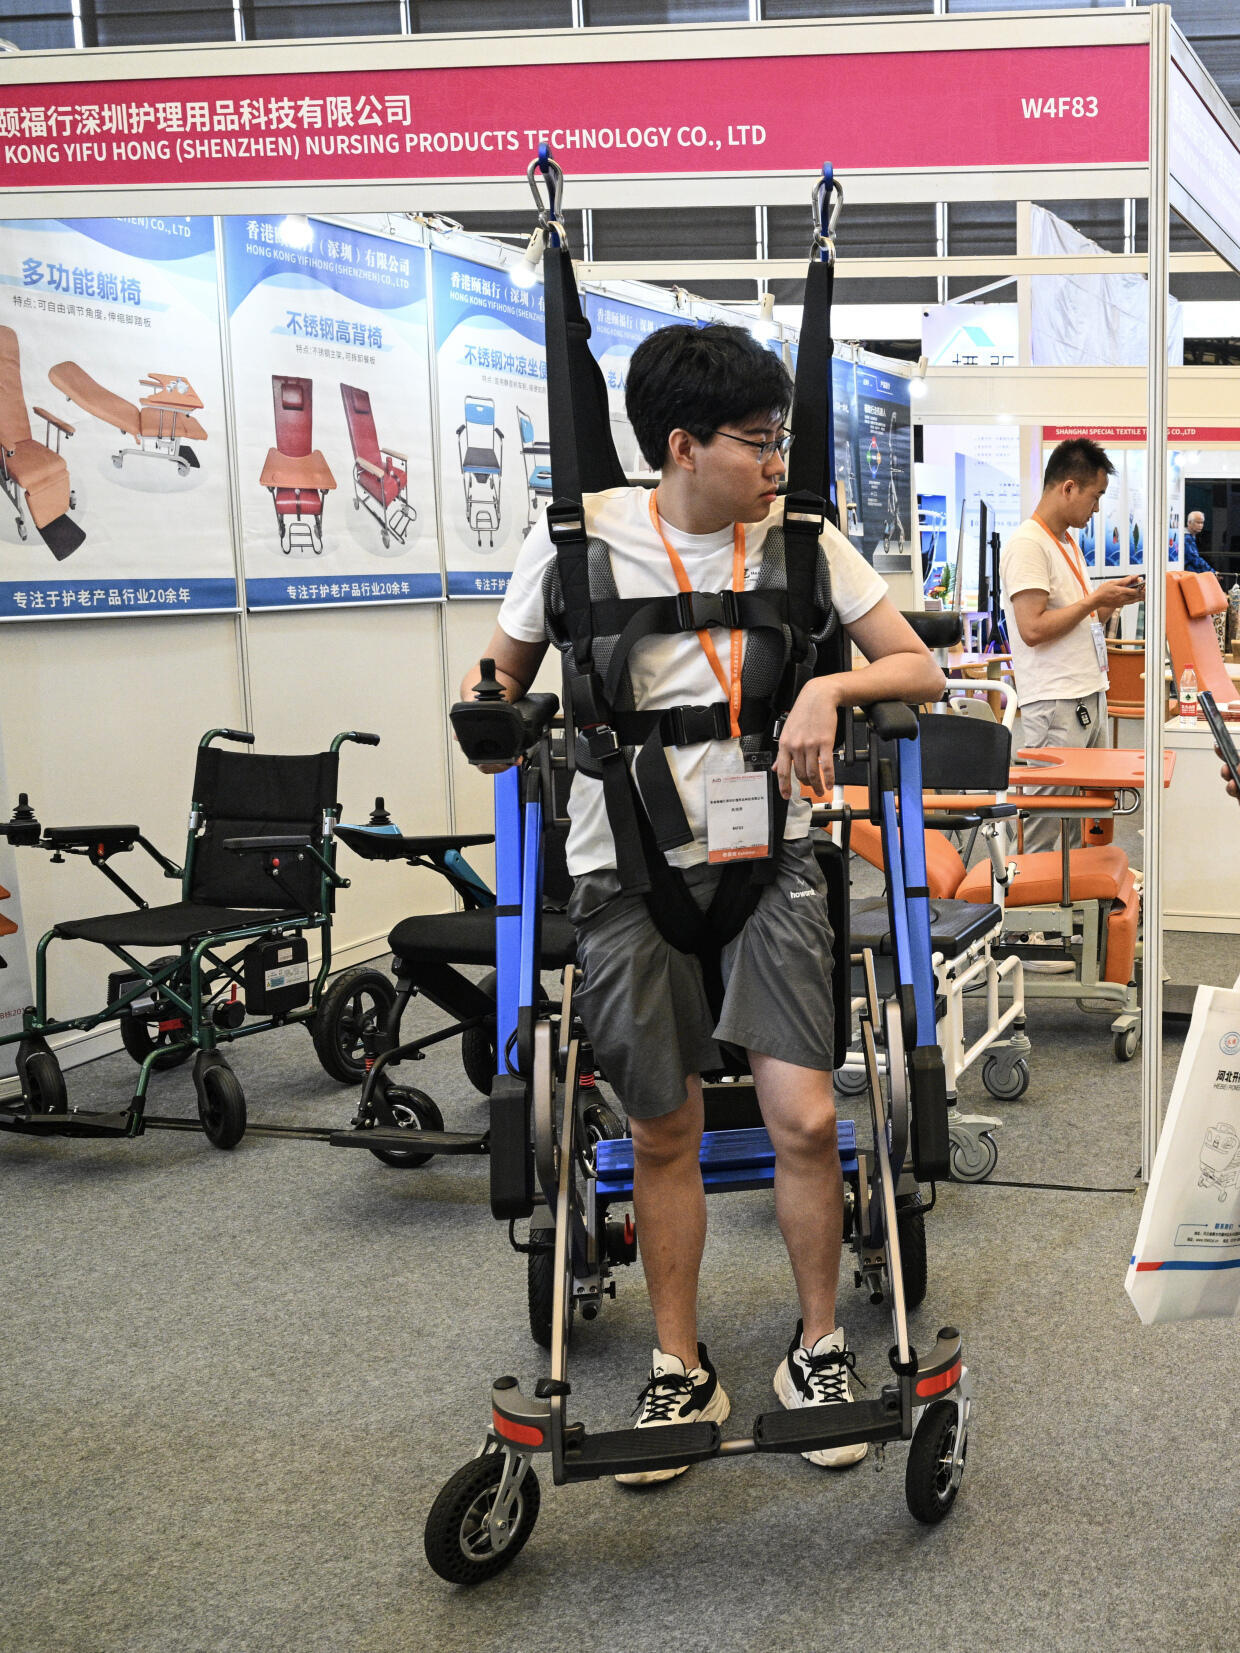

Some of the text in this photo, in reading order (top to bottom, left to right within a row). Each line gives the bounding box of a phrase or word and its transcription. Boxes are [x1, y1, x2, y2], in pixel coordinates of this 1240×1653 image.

[0, 94, 412, 139] 颐福行深圳护理用品科技有限公司
[1021, 96, 1099, 118] W4F83
[5, 143, 59, 164] KONG
[63, 142, 107, 162] YIFU
[112, 140, 171, 161] HONG
[176, 135, 300, 163] (SHENZHEN)
[306, 134, 400, 156] NURSING
[406, 130, 519, 153] PRODUCTS
[677, 126, 722, 150] CO.,
[727, 125, 766, 146] LTD
[246, 220, 410, 276] 香港（深圳）有限公司
[246, 243, 272, 258] HONG
[273, 249, 297, 264] KONG
[22, 257, 142, 306] 多功能躺椅
[286, 310, 382, 349] 不锈钢高背椅
[1056, 428, 1088, 436] SHANGHAI
[1089, 428, 1114, 436] SPECIAL
[1116, 428, 1141, 436] TEXTILE
[13, 587, 191, 608] 专注于护老产品行业20余年
[287, 581, 411, 599] 专注于护老产品行业20余年
